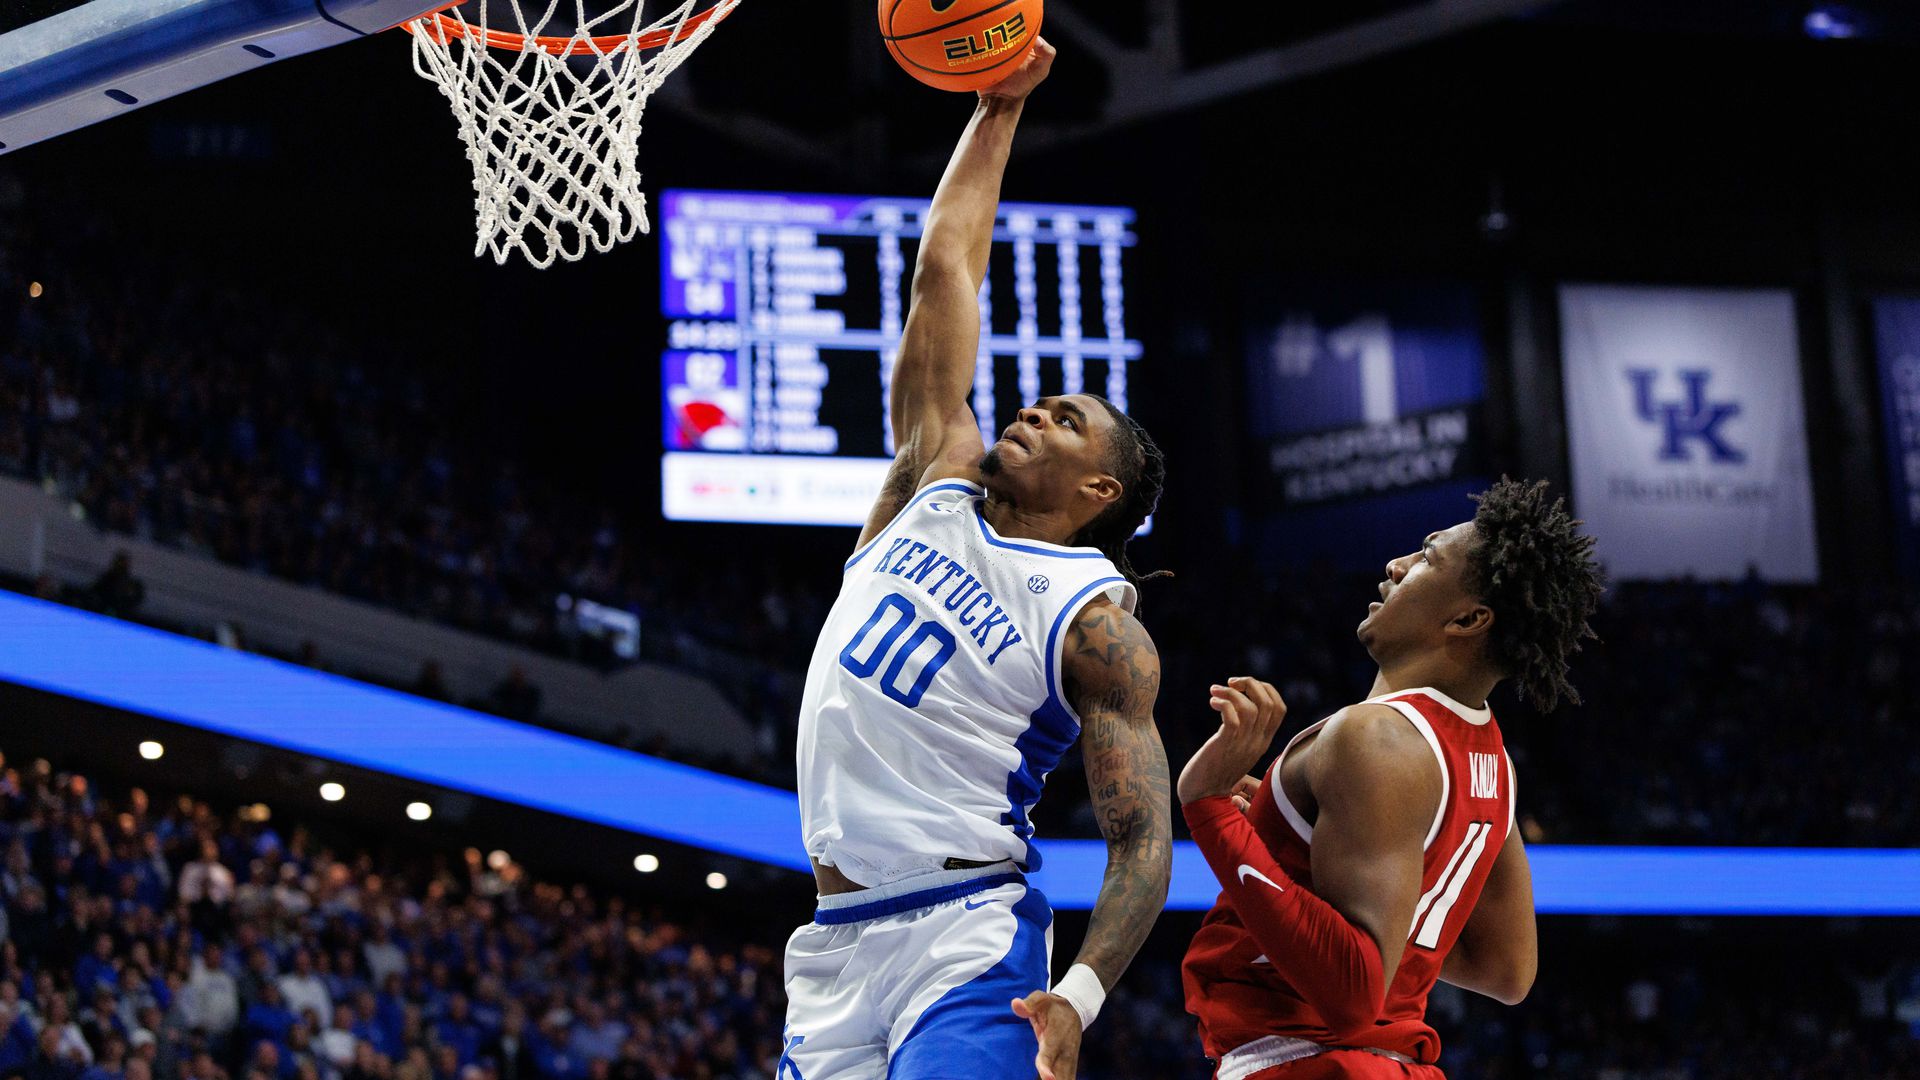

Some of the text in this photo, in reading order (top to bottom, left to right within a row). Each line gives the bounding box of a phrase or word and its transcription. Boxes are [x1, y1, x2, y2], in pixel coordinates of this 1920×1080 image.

[943, 11, 1026, 61] ELITE
[1623, 367, 1747, 466] UK
[873, 537, 1022, 666] KENTUCKY
[1028, 575, 1049, 593] SEC
[839, 592, 957, 709] 00
[1468, 751, 1499, 800] KNOX
[1407, 821, 1494, 951] 11
